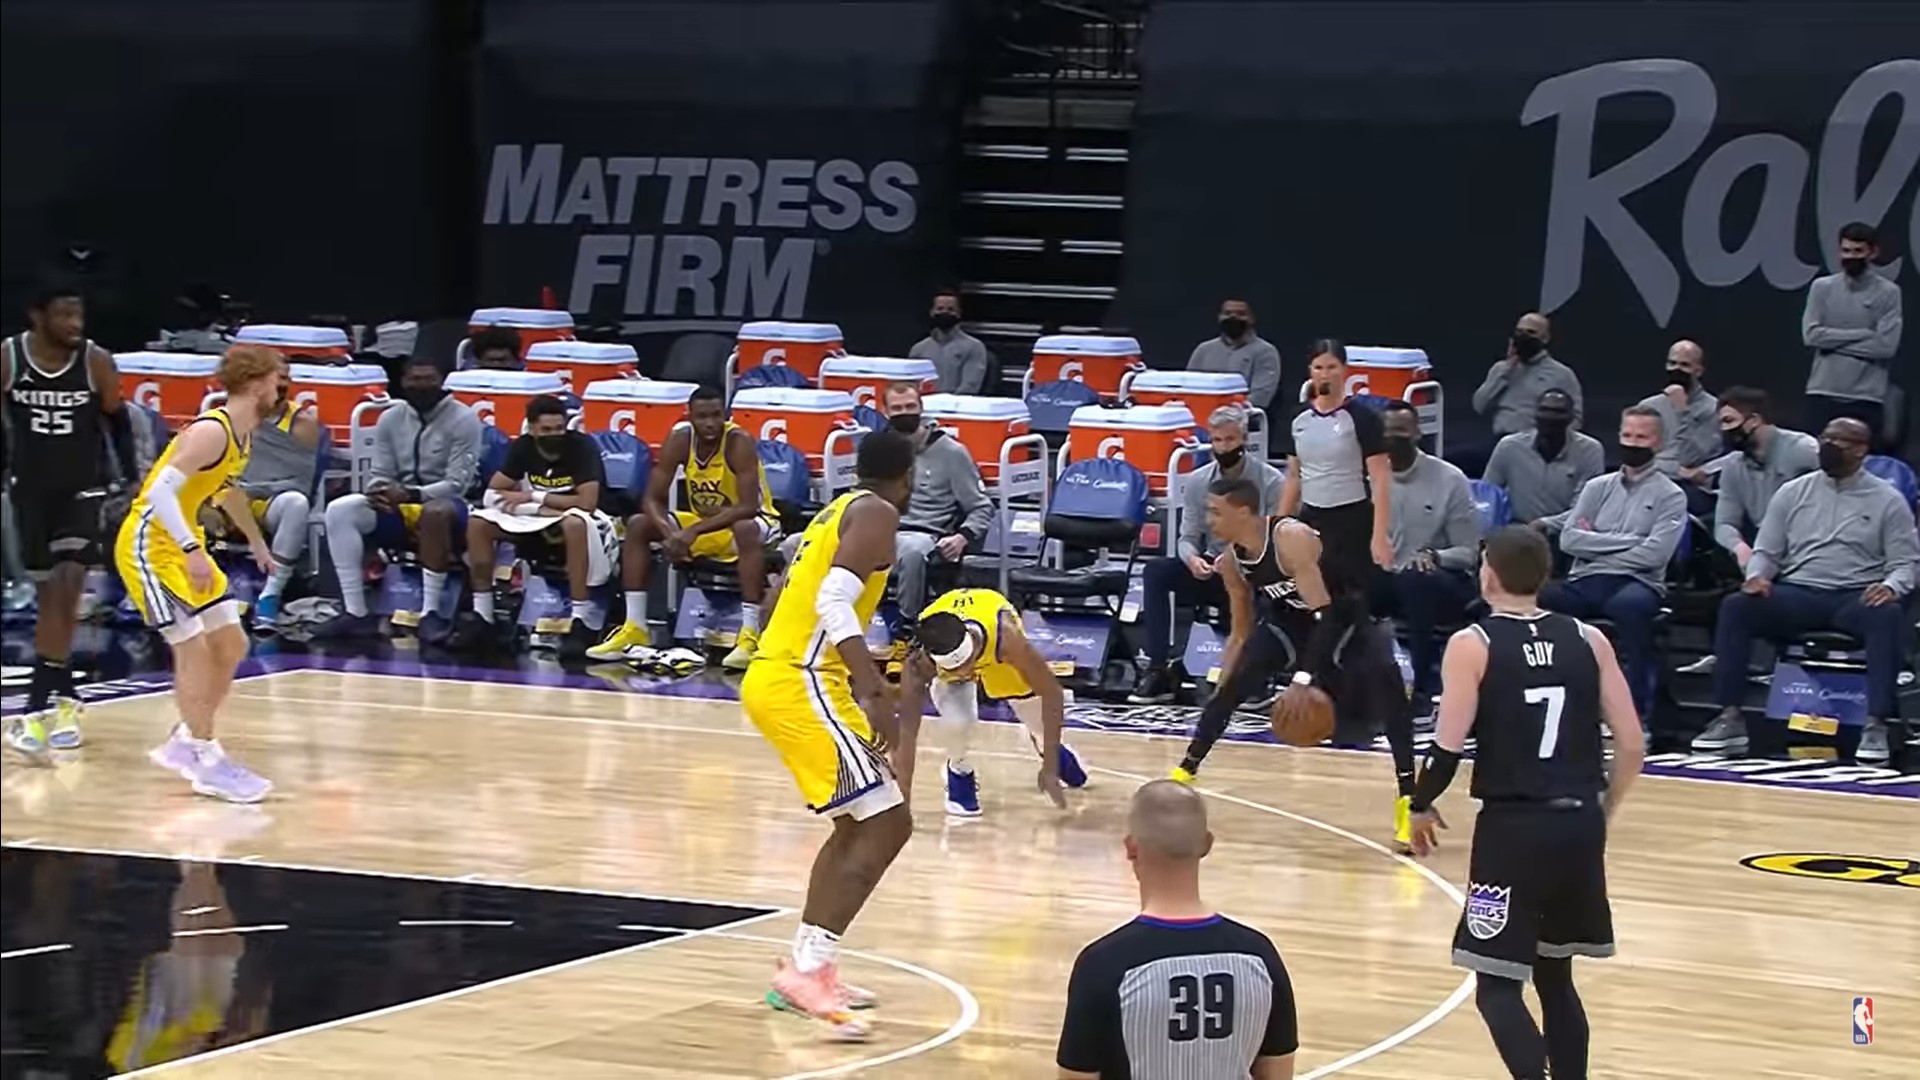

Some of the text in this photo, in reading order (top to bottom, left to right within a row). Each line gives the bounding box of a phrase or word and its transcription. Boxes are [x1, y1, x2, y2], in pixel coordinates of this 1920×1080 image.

[483, 143, 920, 233] MATTRESS
[1520, 58, 1920, 330] Ral
[568, 234, 815, 319] FIRM
[12, 388, 89, 407] KINGS
[30, 408, 74, 434] 25
[690, 480, 721, 492] BAY
[1523, 641, 1554, 667] GUY
[1524, 686, 1566, 759] 7
[1168, 972, 1234, 1042] 39
